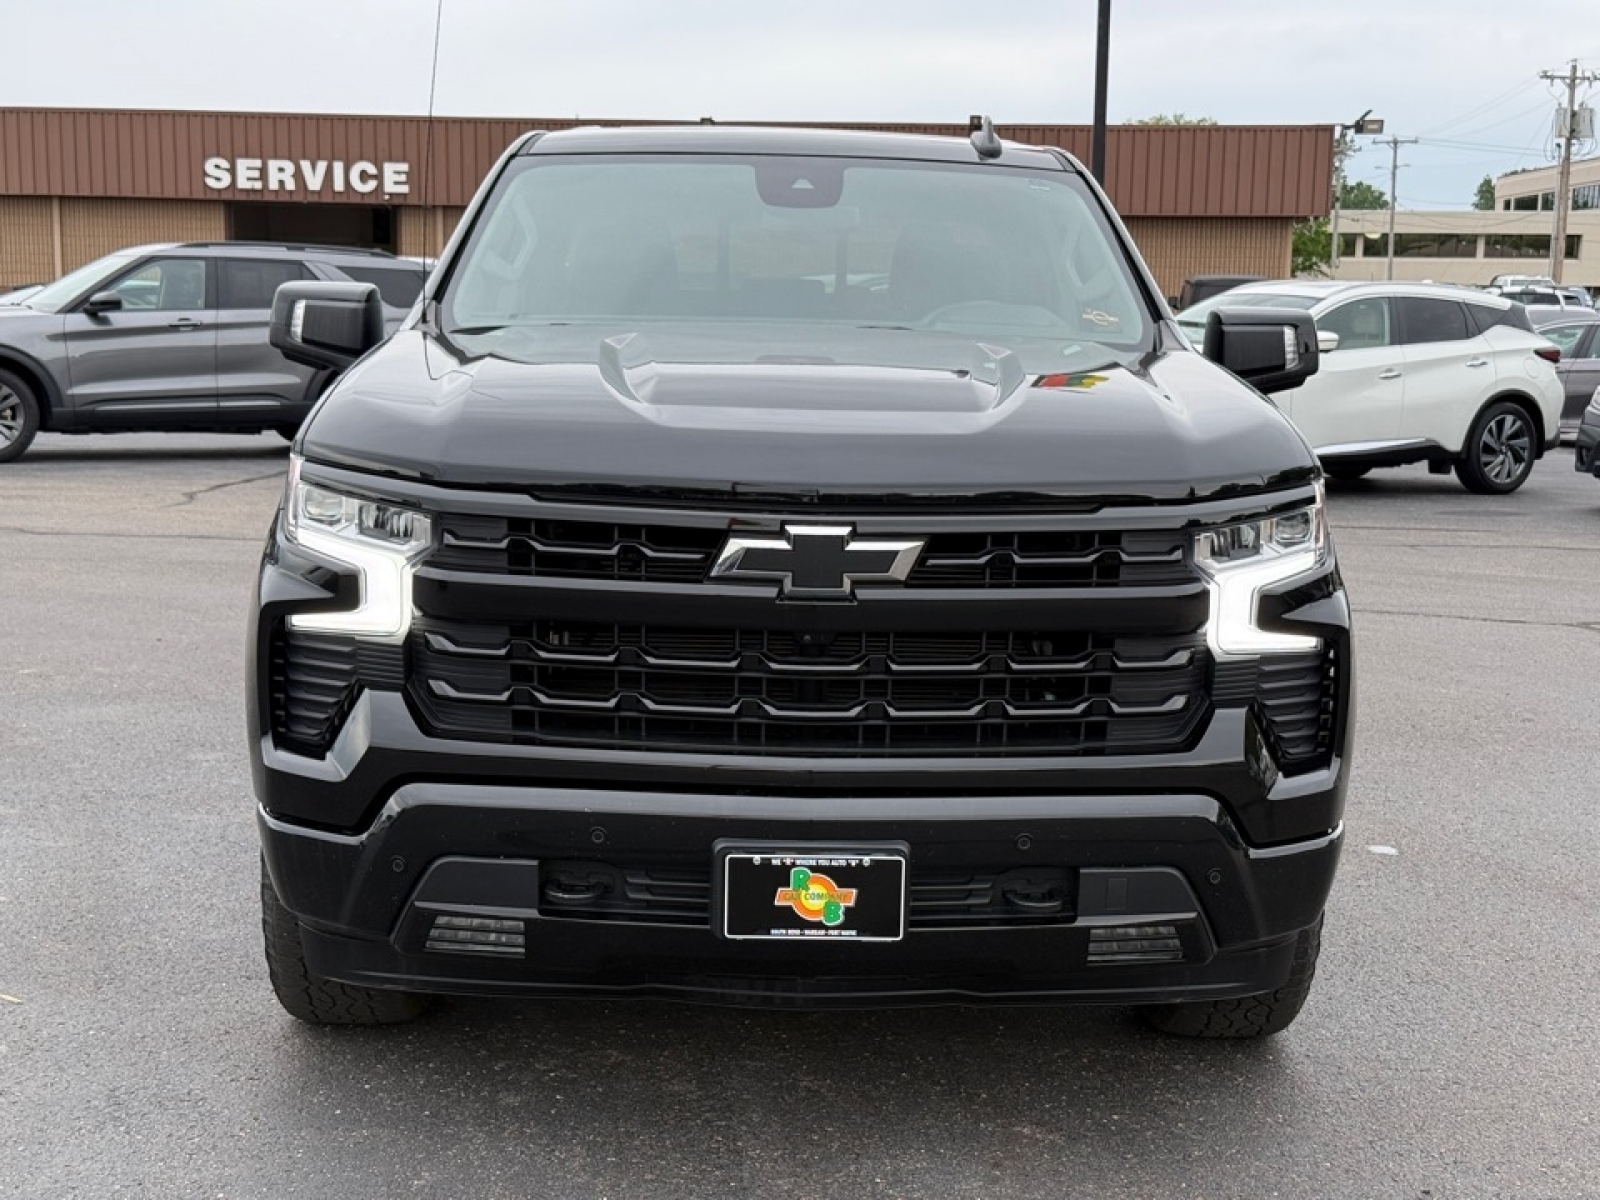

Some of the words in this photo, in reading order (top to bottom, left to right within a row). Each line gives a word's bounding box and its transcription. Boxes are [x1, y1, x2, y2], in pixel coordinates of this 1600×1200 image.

[204, 156, 410, 195] SERVICE
[791, 867, 811, 891] R
[804, 892, 847, 901] COMPANY
[822, 900, 844, 926] B
